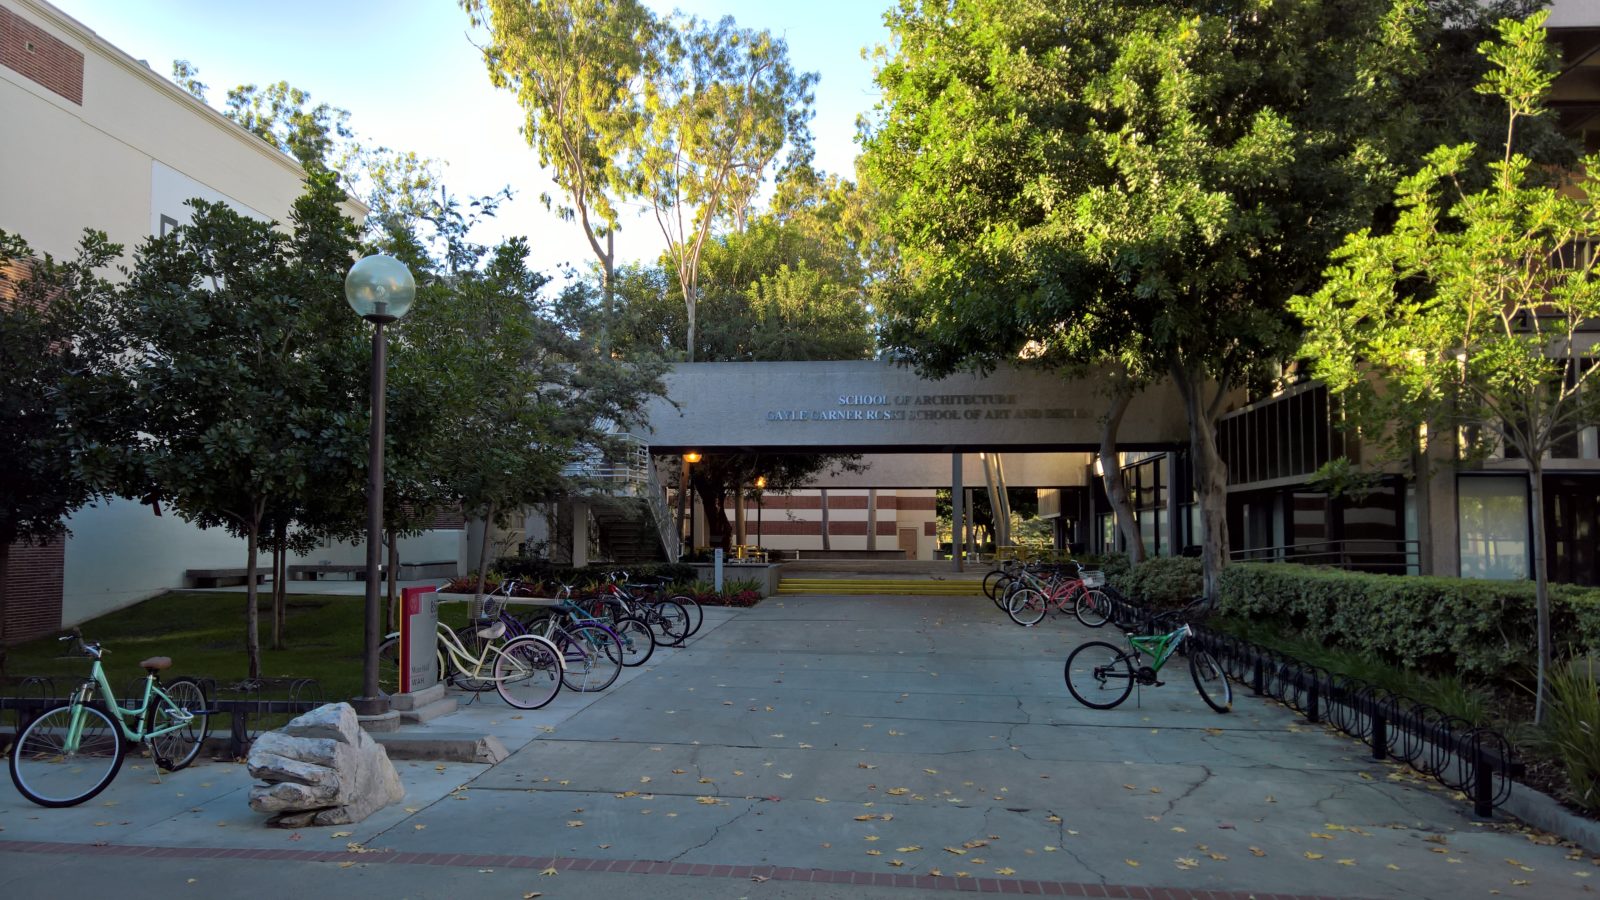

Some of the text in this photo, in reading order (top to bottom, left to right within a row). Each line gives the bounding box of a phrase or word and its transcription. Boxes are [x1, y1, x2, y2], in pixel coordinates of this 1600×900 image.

[838, 394, 1017, 406] SCHOOL OF ARCHITECTURE
[767, 410, 808, 421] GAYLE
[908, 409, 961, 420] SCHOOL
[963, 409, 981, 420] OF
[984, 409, 1011, 420] ART
